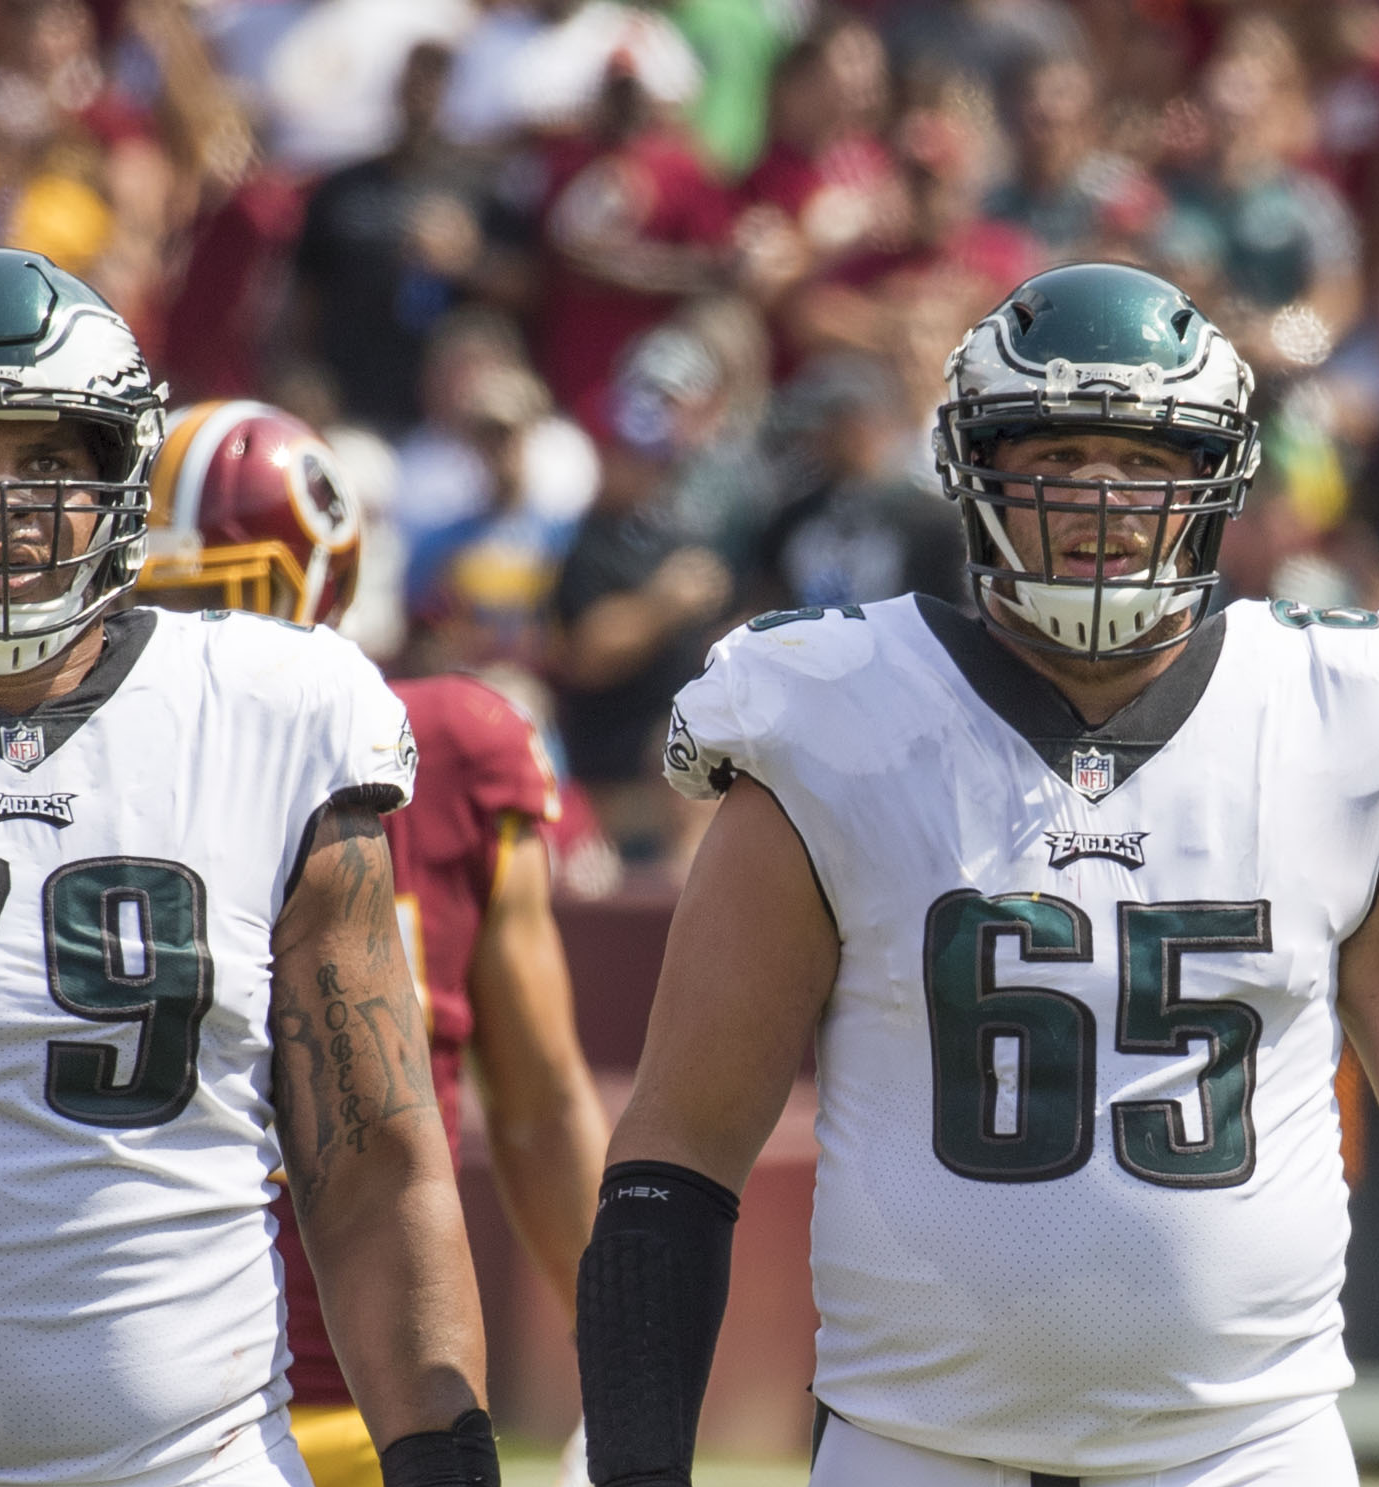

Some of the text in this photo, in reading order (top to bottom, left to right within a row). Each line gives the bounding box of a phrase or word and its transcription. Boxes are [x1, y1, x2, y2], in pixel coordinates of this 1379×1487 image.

[9, 743, 39, 760] NFL
[1079, 770, 1107, 789] NFL
[1043, 831, 1151, 872] EAGLES
[923, 888, 1273, 1190] 65
[316, 959, 373, 1154] ROBERT
[618, 1186, 670, 1200] HEX
